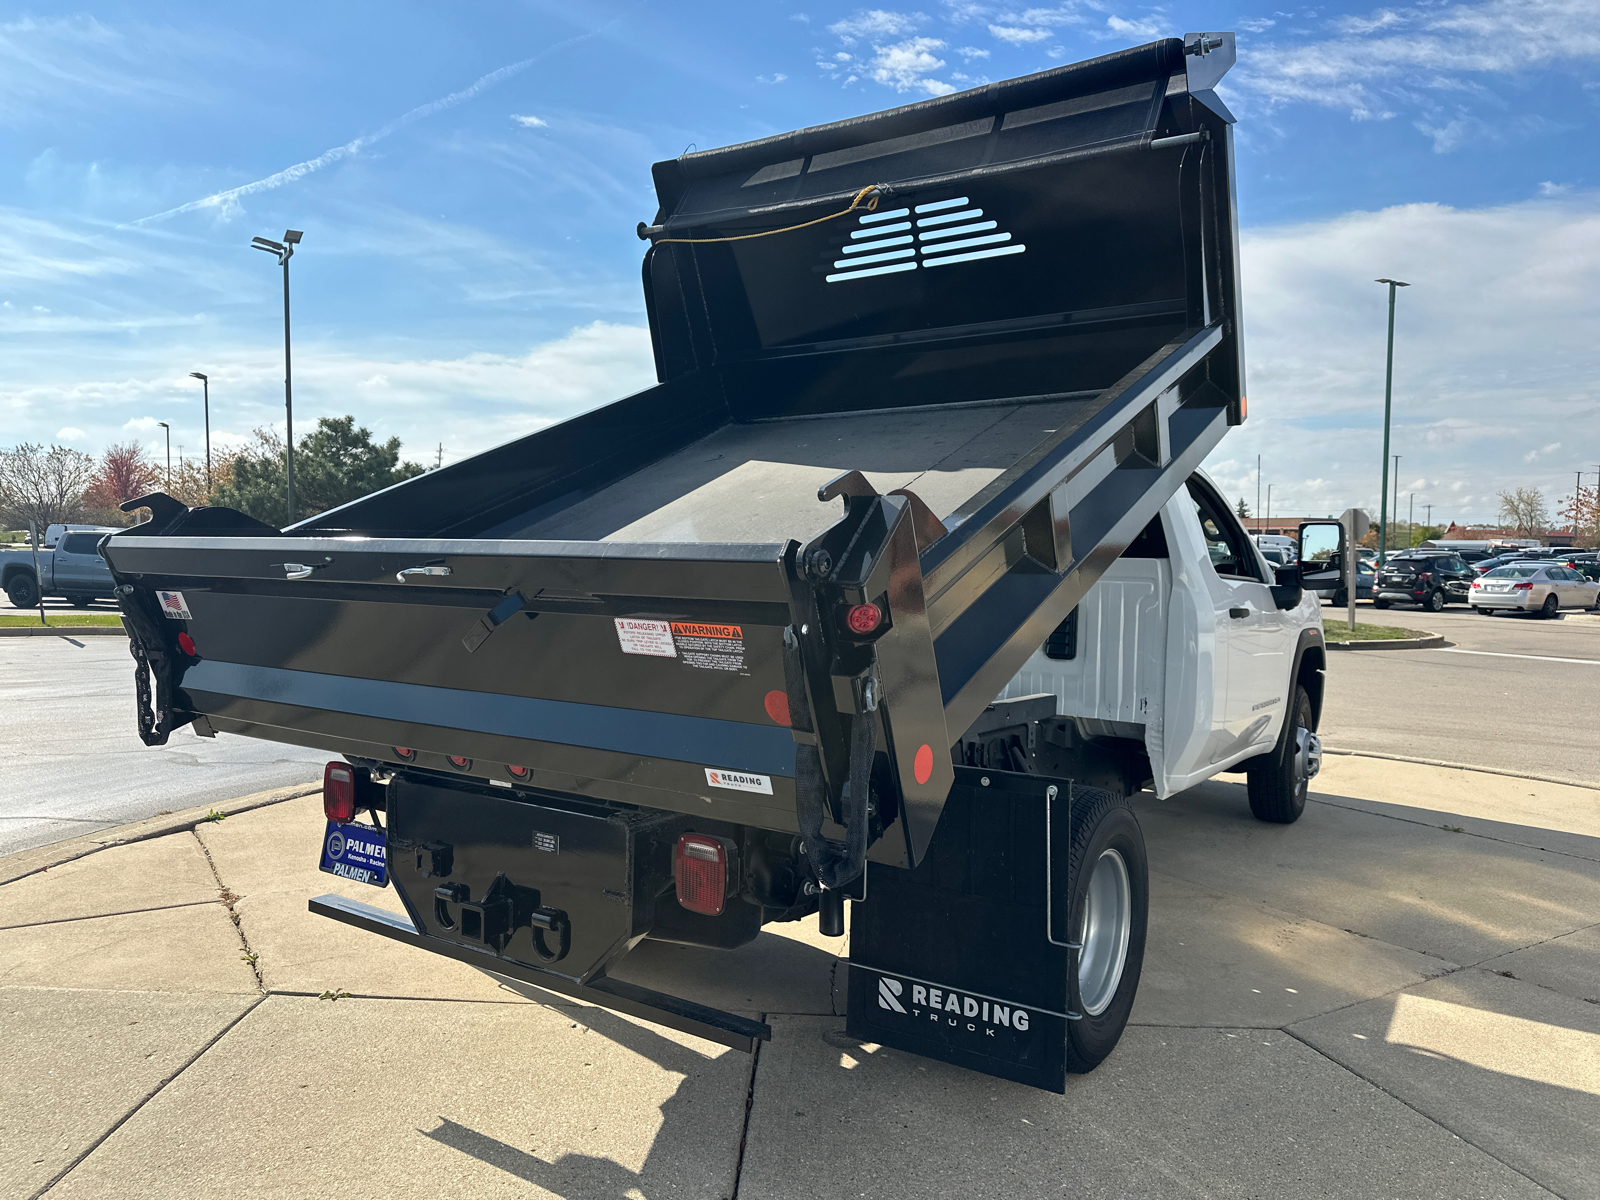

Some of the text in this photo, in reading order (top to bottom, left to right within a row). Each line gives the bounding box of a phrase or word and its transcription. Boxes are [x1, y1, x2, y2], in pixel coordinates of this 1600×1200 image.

[682, 625, 730, 636] WARNING
[721, 774, 761, 785] READING
[346, 838, 386, 859] PALMEN
[348, 853, 366, 863] Kenosha
[370, 858, 385, 868] Racine
[333, 862, 370, 883] PALMEN
[912, 984, 1029, 1031] READING
[912, 1009, 995, 1037] TRUCK
